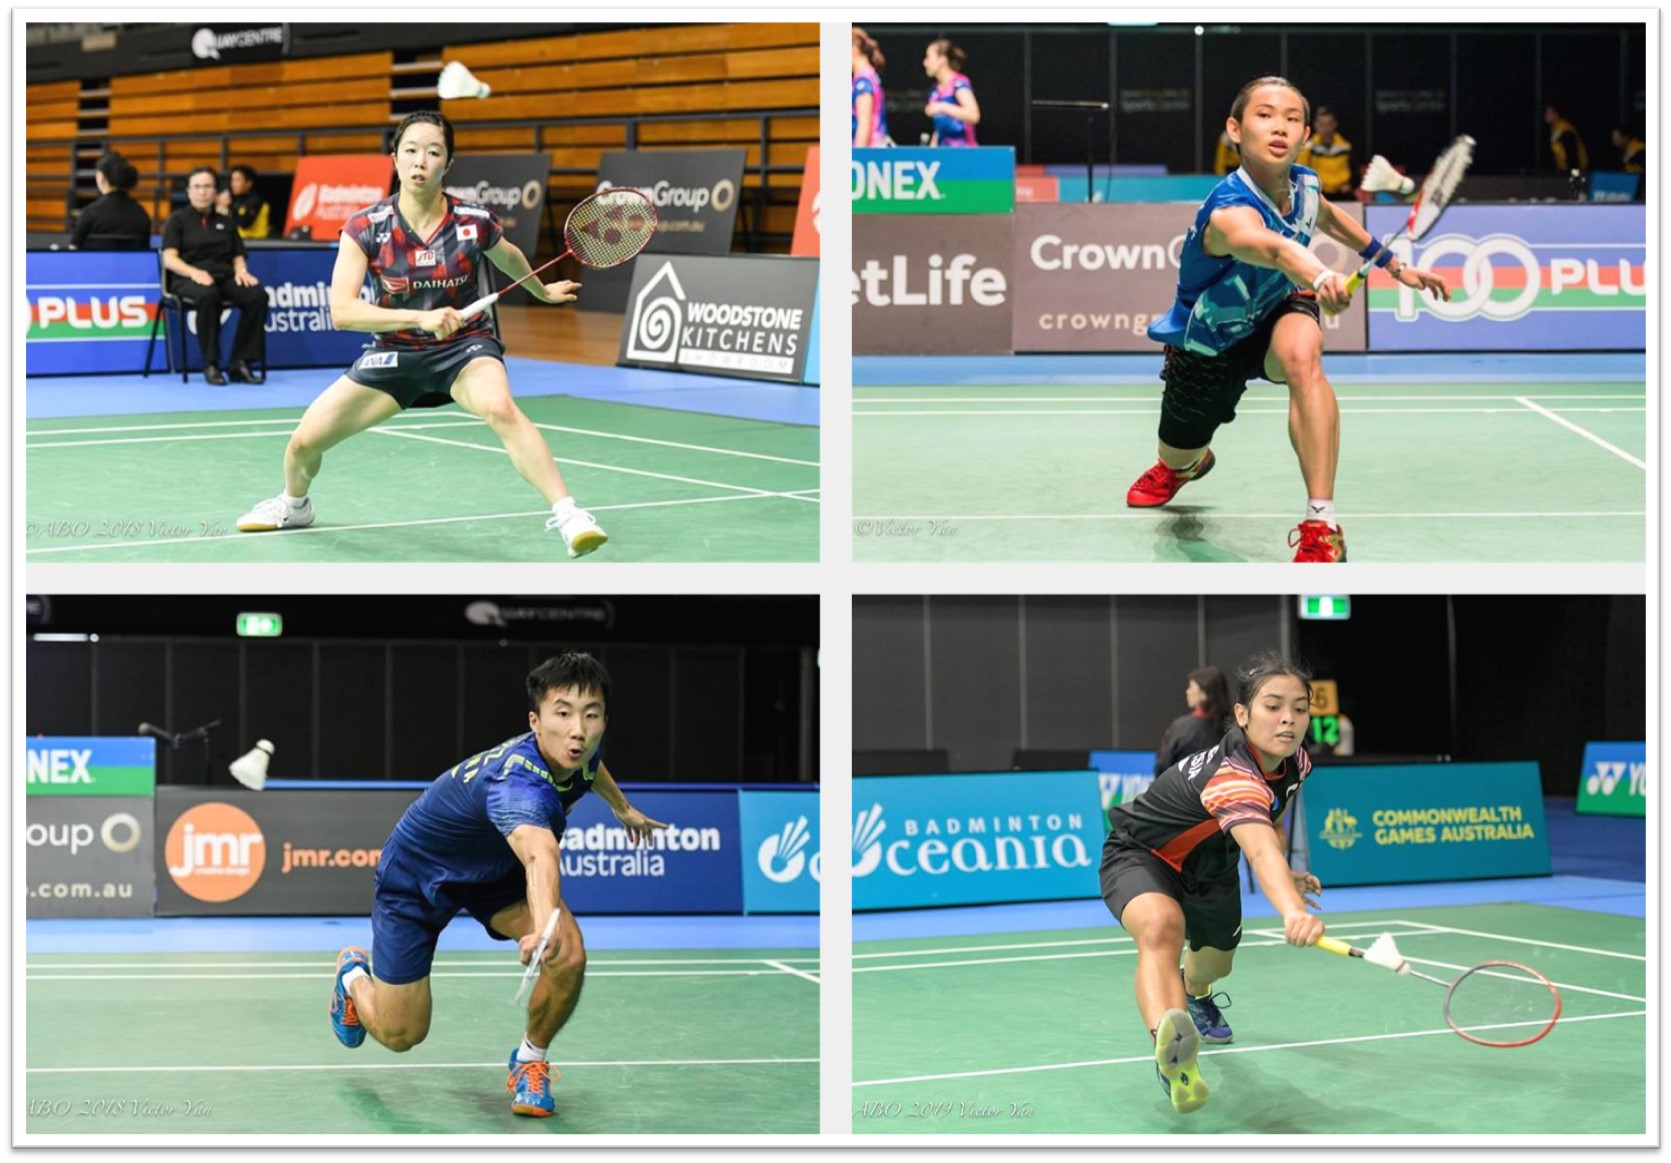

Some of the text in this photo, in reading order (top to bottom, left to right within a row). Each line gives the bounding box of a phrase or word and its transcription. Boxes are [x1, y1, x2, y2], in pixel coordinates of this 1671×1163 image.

[852, 254, 1007, 307] tLife
[1386, 236, 1541, 318] 100
[38, 295, 148, 330] PLUS
[687, 302, 803, 331] WOODSTONE
[681, 325, 798, 356] KITCHENS
[905, 813, 1083, 837] BADMINTON
[1372, 806, 1522, 828] COMMONWEALTH
[560, 823, 721, 850] adminton
[1374, 823, 1535, 846] GAMES AUSTRALIA
[169, 823, 263, 877] jmr
